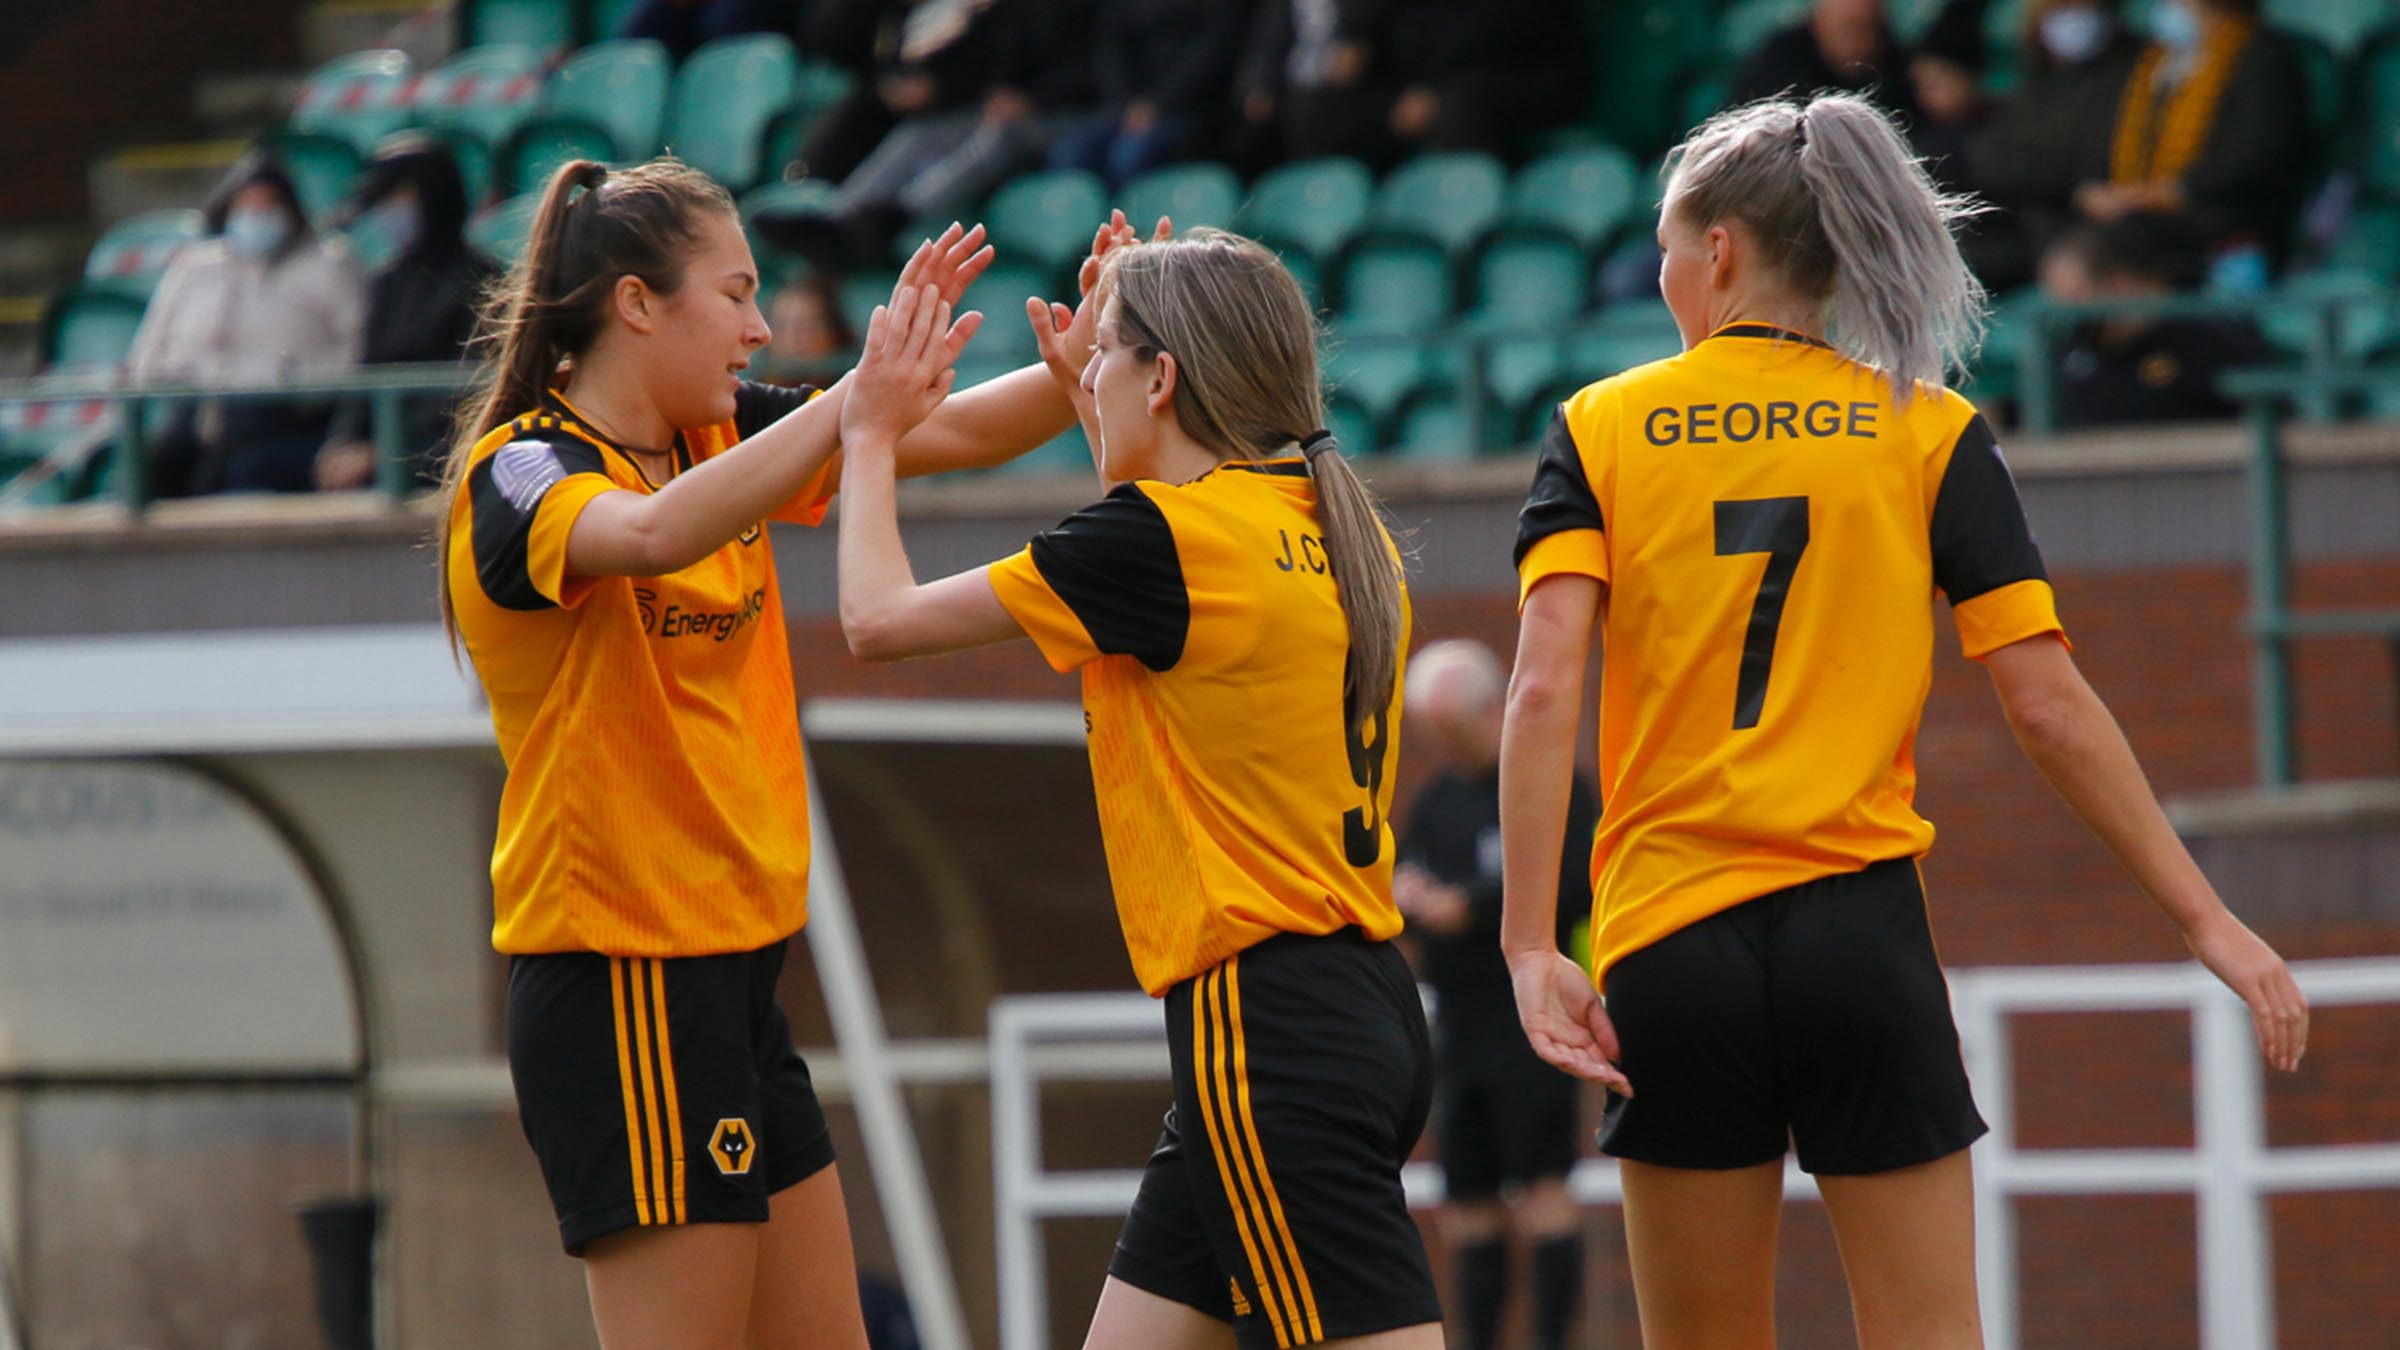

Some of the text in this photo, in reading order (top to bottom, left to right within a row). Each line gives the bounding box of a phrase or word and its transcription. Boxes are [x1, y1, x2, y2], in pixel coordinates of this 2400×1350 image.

[1644, 400, 1878, 446] GEORGE
[1713, 496, 1810, 730] 7
[1343, 643, 1388, 868] 9
